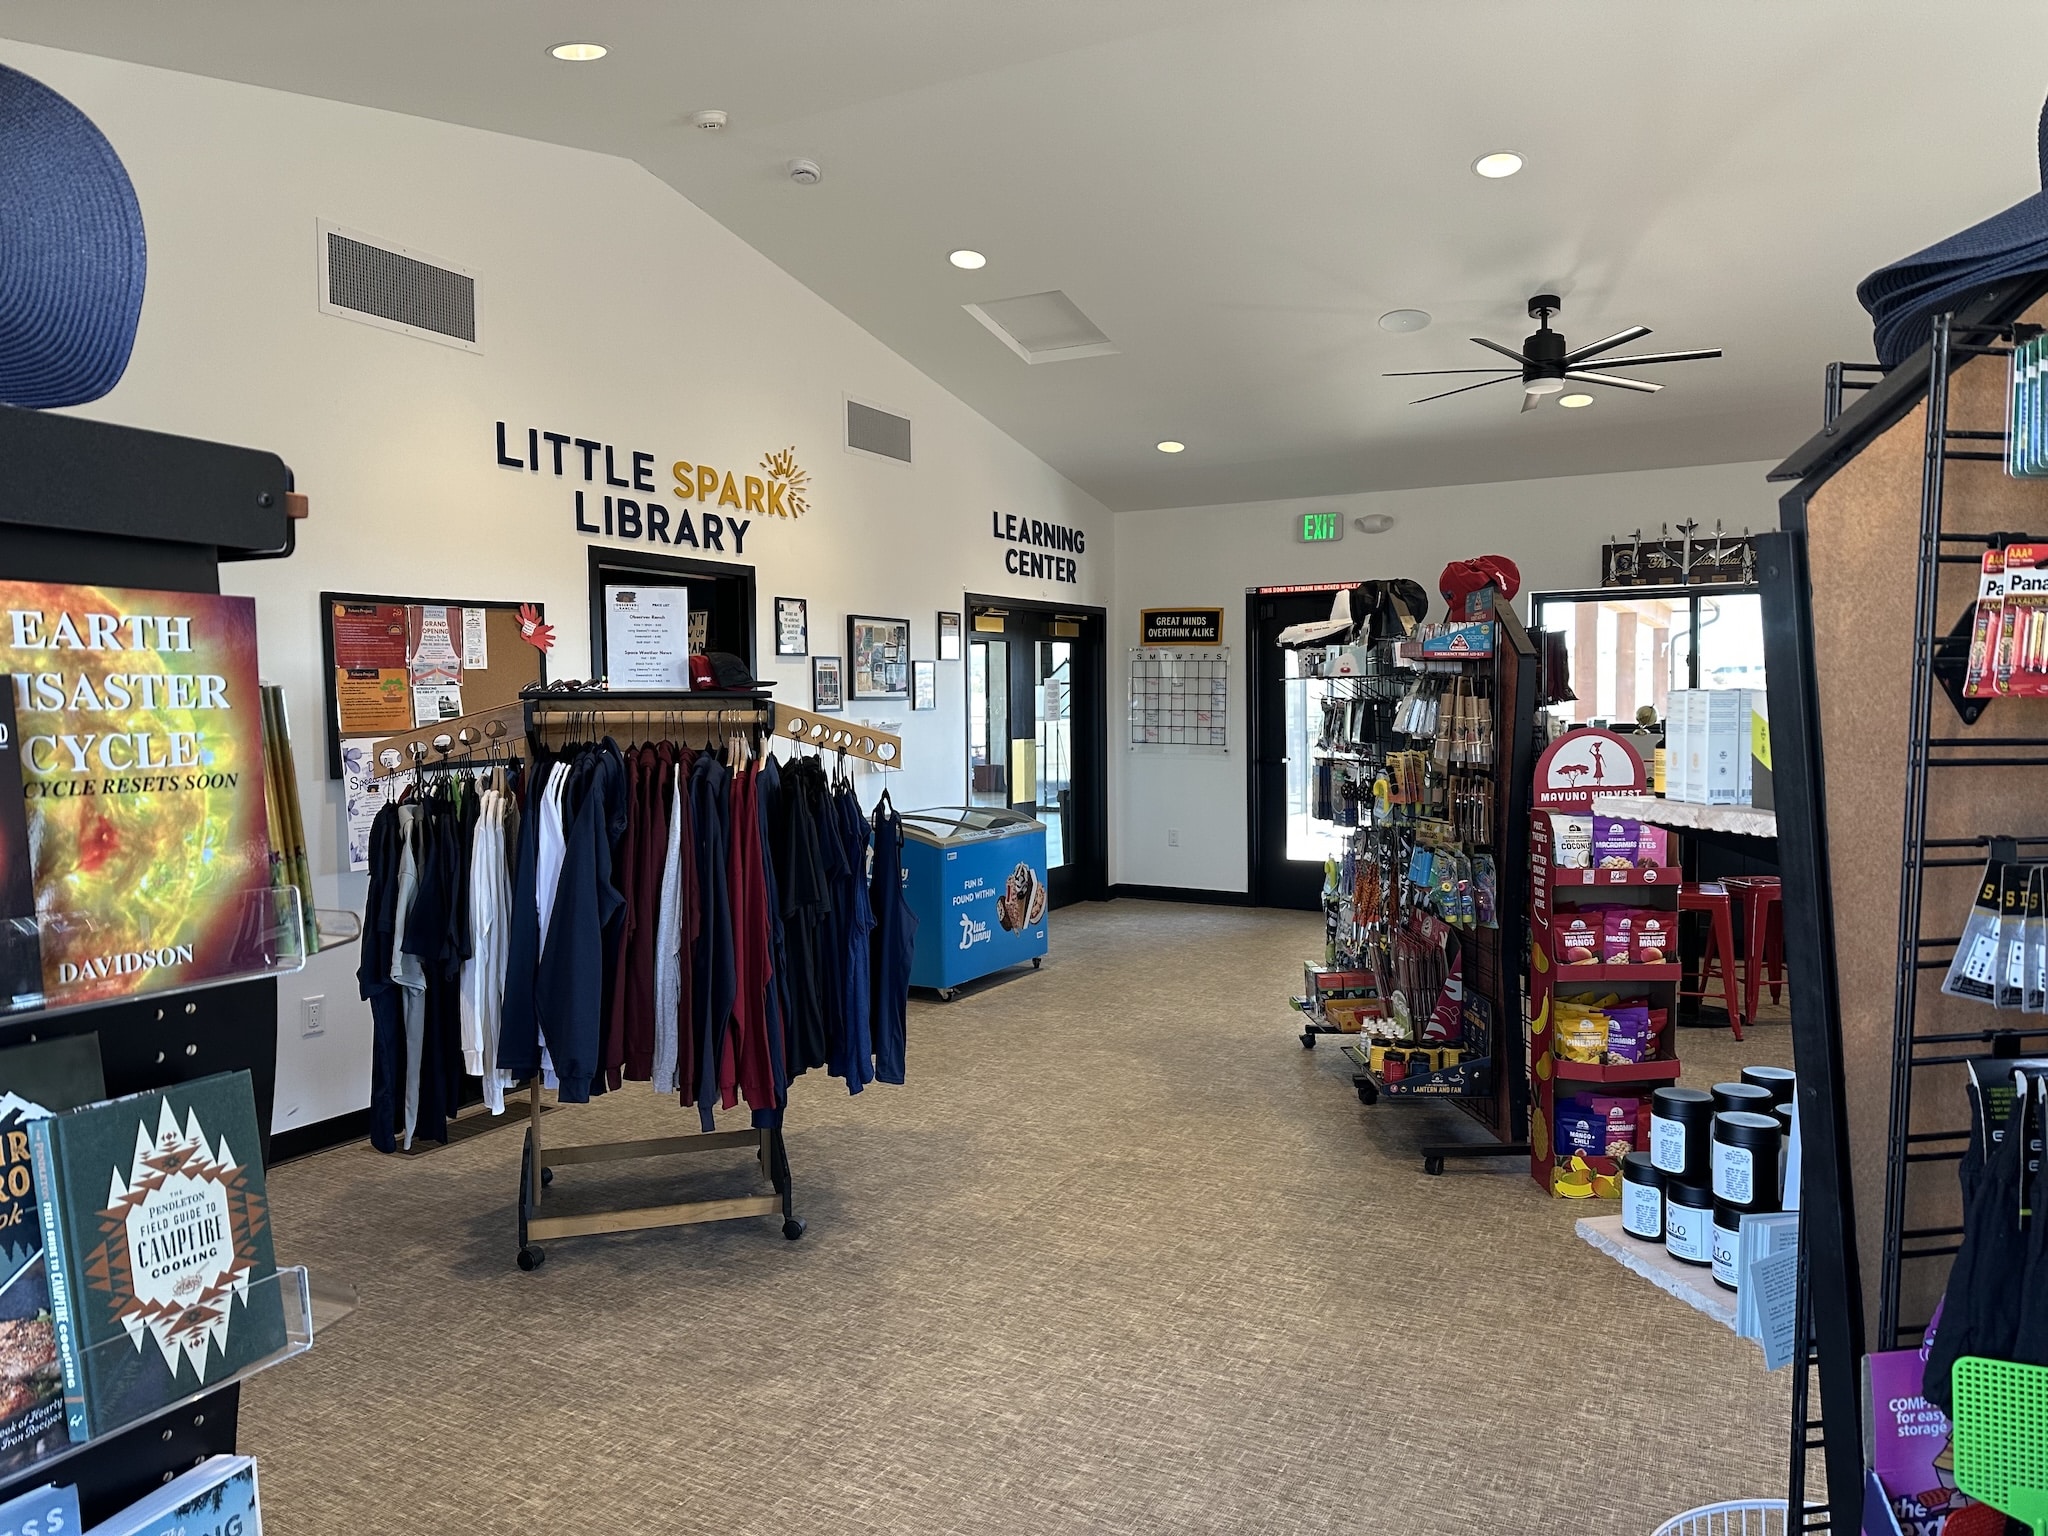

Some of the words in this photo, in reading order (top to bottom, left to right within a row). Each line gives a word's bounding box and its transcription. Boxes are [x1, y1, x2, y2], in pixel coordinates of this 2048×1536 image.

[496, 421, 655, 492] LITTLE
[673, 461, 788, 518] SPARK
[575, 490, 751, 554] LIBRARY
[993, 511, 1085, 554] LEARNING
[1303, 513, 1337, 540] EXIT
[1005, 549, 1077, 584] CENTER
[2008, 595, 2042, 605] ALKALINE
[8, 610, 194, 653] EARTH
[1156, 617, 1180, 626] GREAT
[1182, 616, 1207, 625] MINDS
[1148, 628, 1189, 637] OVERTHINK
[1192, 628, 1214, 637] ALIKE
[13, 672, 232, 713] ISASTER
[22, 732, 199, 774] CYCLE
[24, 780, 96, 799] CYCLE
[102, 776, 180, 795] RESETS
[184, 773, 239, 791] SOON
[1540, 791, 1587, 802] MAVUNO
[1561, 842, 1591, 850] COCONU
[1595, 841, 1637, 849] MACADAMIAS
[964, 879, 976, 890] FUN
[976, 878, 983, 887] IS
[952, 894, 974, 906] FOUND
[975, 888, 996, 900] WITHIN
[1565, 939, 1595, 947] MANGO
[1639, 939, 1666, 947] MANGO
[58, 944, 194, 984] DAVIDSON
[1608, 1038, 1637, 1046] DAMIAS
[1412, 1086, 1438, 1094] LANTERN
[1438, 1086, 1450, 1094] AND
[1451, 1086, 1462, 1094] FAN
[1569, 1131, 1592, 1140] MANGO
[170, 1189, 183, 1198] THE
[43, 1202, 55, 1229] FIELD
[149, 1191, 206, 1219] PENDLETON
[140, 1218, 169, 1237] FIELD
[173, 1207, 201, 1225] GUIDE
[206, 1202, 216, 1214] TO
[1667, 1222, 1686, 1236] ALO
[138, 1214, 224, 1269] CAMPFIRE
[151, 1247, 218, 1279] COOKING
[1713, 1245, 1731, 1261] ALO
[50, 1272, 69, 1324] CAMPFIRE
[58, 1324, 75, 1389] COOKING
[18, 1414, 29, 1430] of
[29, 1398, 63, 1424] Hearty
[1896, 1410, 1916, 1424] for
[1917, 1410, 1946, 1424] easy
[1, 1433, 23, 1451] Iron
[25, 1411, 62, 1439] Recipes
[1898, 1423, 1947, 1437] storage
[1893, 1498, 1927, 1518] the
[1900, 1515, 1946, 1536] ext
